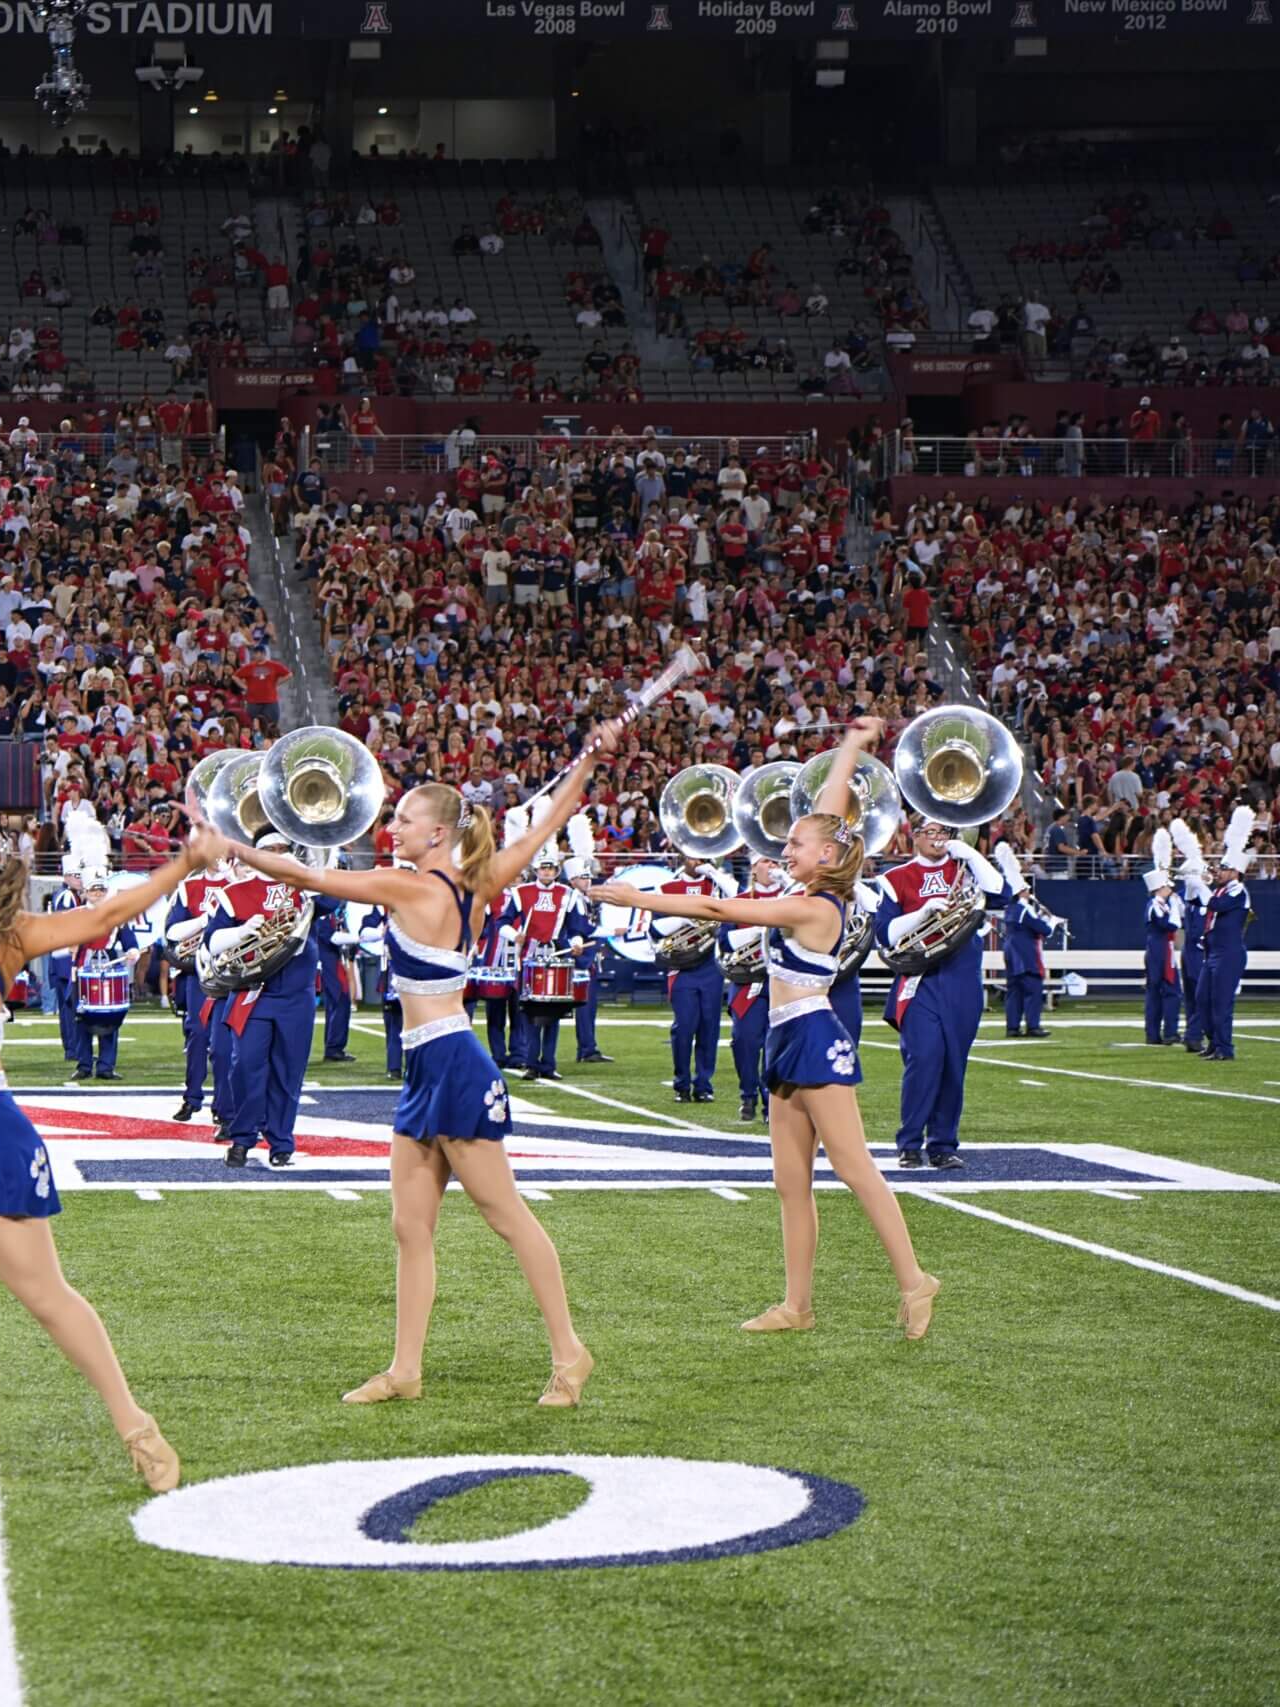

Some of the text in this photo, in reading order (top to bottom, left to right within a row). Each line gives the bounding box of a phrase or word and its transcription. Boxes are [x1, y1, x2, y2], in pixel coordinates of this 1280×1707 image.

[486, 1, 625, 21] Las Vegas Bowl
[698, 1, 815, 21] Holiday Bowl
[883, 0, 992, 16] Alamo Bowl
[1064, 0, 1228, 12] New Mexico Bowl
[86, 2, 273, 35] STADIUM
[915, 18, 958, 33] 2010
[1123, 15, 1167, 30] 2012
[534, 19, 576, 34] 2008
[735, 19, 777, 34] 2009
[260, 375, 293, 384] SECTN
[920, 869, 950, 898] A
